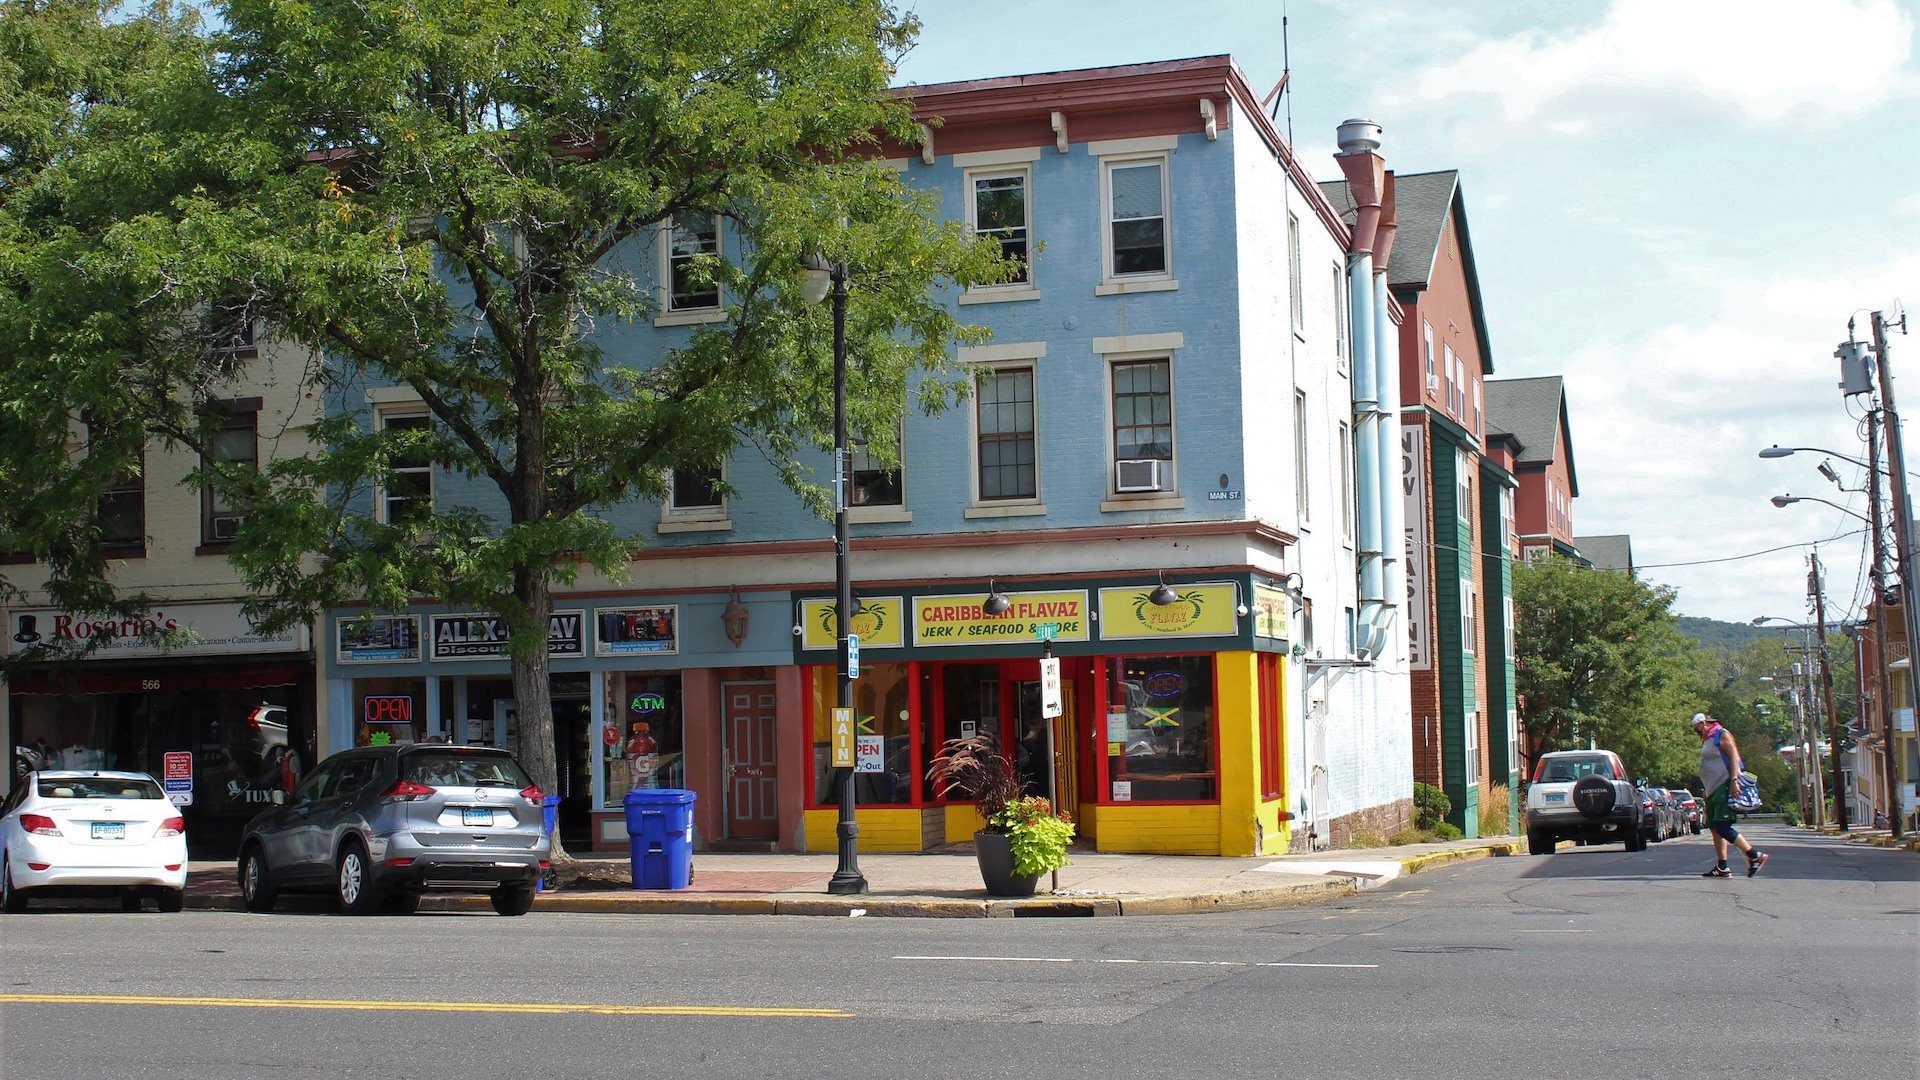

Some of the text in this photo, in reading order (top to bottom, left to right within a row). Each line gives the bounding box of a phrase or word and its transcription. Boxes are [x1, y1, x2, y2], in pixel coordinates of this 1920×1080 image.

[1209, 491, 1240, 500] MAIN ST.
[1405, 528, 1417, 664] EASING
[1019, 601, 1079, 618] FLAVAZ
[53, 611, 177, 641] Rosario's
[922, 626, 953, 637] JERK
[968, 623, 1024, 636] SEAFOOD
[1028, 622, 1037, 633] &
[142, 680, 160, 690] 566
[367, 699, 410, 720] OPEN
[631, 697, 665, 709] ATM
[836, 710, 850, 760] MAIN
[857, 745, 880, 756] PEN
[245, 789, 272, 802] TUX
